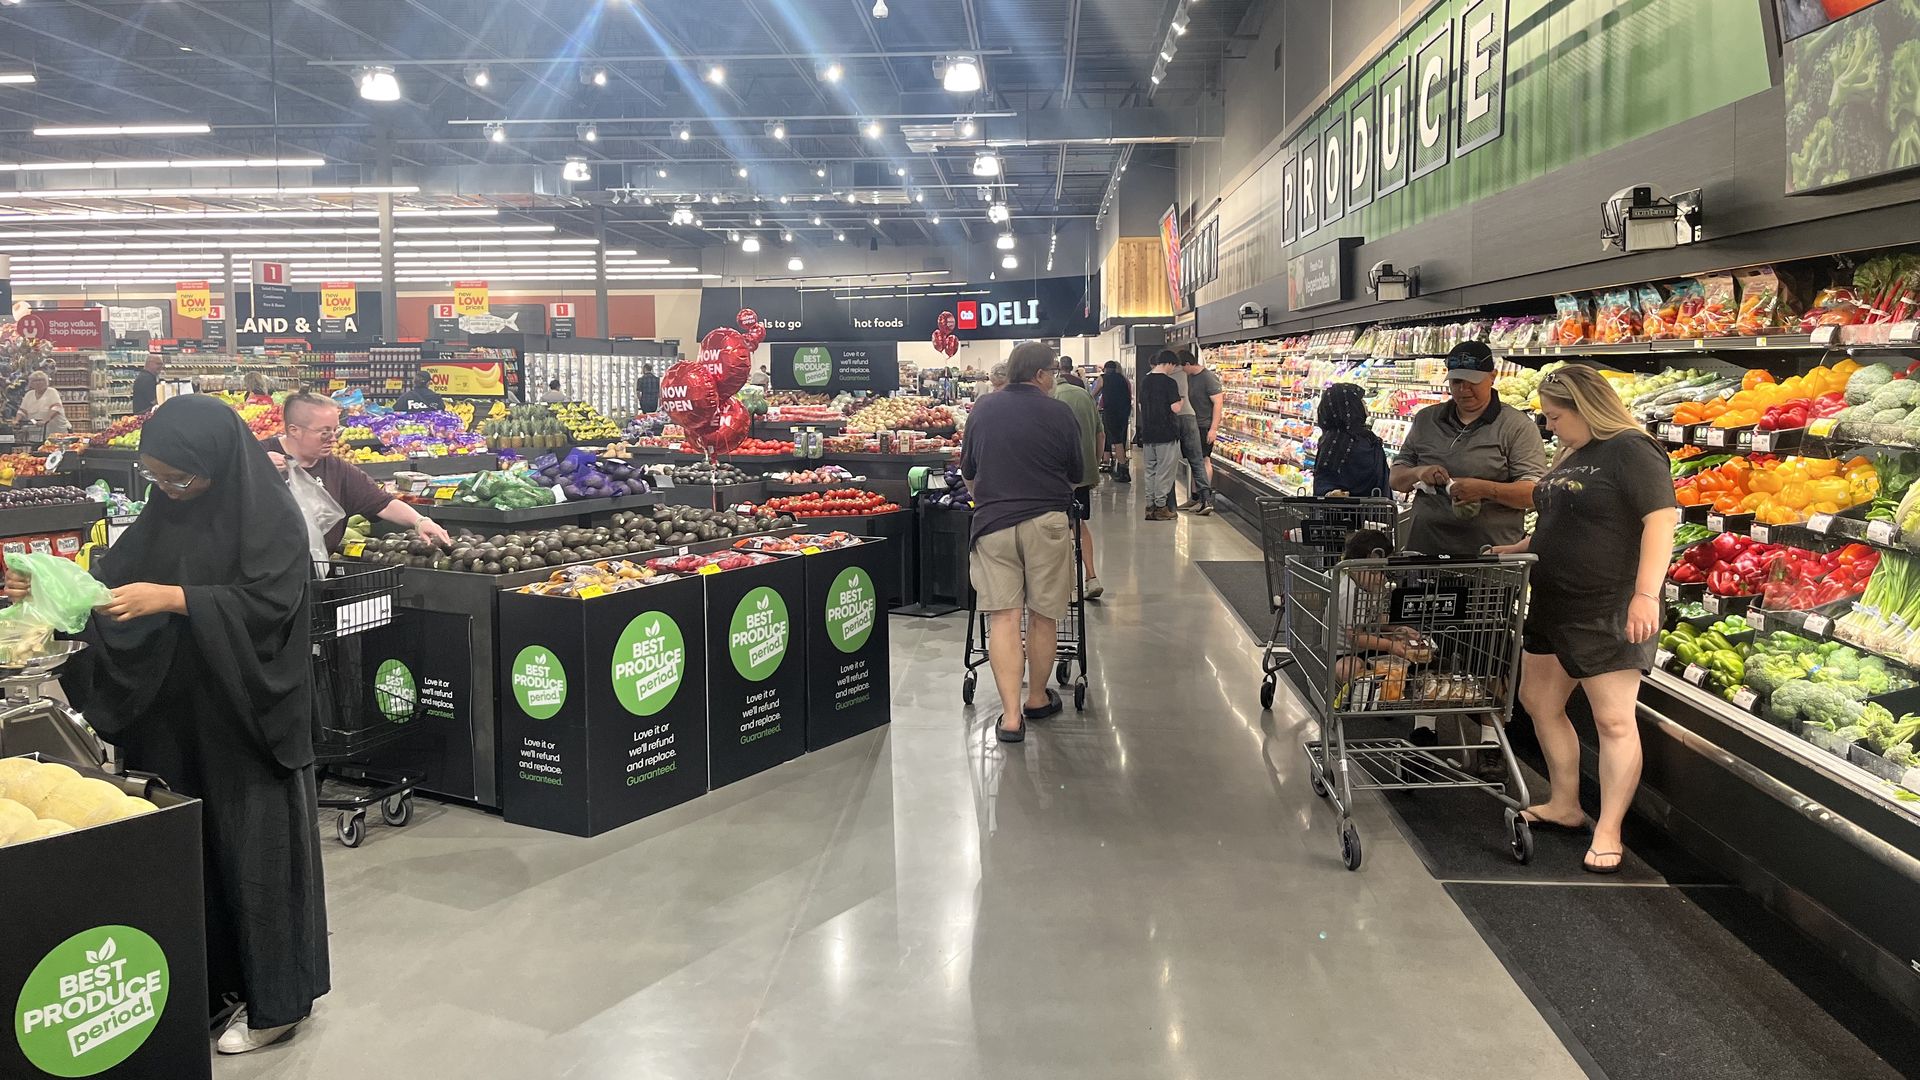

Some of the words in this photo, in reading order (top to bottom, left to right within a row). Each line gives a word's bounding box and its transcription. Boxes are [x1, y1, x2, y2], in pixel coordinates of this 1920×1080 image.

[1284, 12, 1494, 230] PRODUCE
[270, 266, 276, 280] 1
[181, 299, 206, 308] LOW
[326, 298, 351, 306] LOW
[459, 297, 484, 306] LOW
[443, 306, 449, 316] 2
[980, 300, 1040, 326] DELI
[49, 320, 70, 329] Shop
[295, 318, 312, 333] &
[775, 320, 786, 328] to
[786, 321, 802, 331] go
[854, 318, 872, 328] hot
[874, 318, 904, 328] foods
[49, 328, 70, 336] Shop
[804, 354, 821, 363] BEST
[794, 362, 830, 371] PRODUCE
[430, 374, 450, 386] OW
[662, 386, 688, 398] NOW
[663, 400, 694, 412] OPEN
[840, 588, 862, 605] BEST
[828, 598, 874, 622] PRODUCE
[746, 610, 774, 629] BEST
[844, 614, 870, 638] period.
[732, 620, 786, 648] PRODUCE
[632, 636, 665, 659] BEST
[752, 635, 782, 664] period.
[526, 664, 550, 678] BEST
[616, 648, 682, 680] PRODUCE
[840, 664, 854, 674] Love
[854, 660, 859, 669] it
[859, 660, 865, 668] or
[386, 675, 404, 685] BEST
[424, 677, 437, 685] Love
[514, 674, 564, 691] PRODUCE
[639, 665, 676, 698] period.
[837, 674, 850, 687] we'll
[850, 669, 869, 682] refund
[376, 684, 414, 700] PRODUCE
[434, 690, 453, 698] refund
[530, 692, 559, 704] period.
[746, 693, 762, 704] Love
[763, 689, 768, 699] it
[768, 688, 776, 697] or
[836, 688, 848, 699] and
[848, 682, 870, 696] replace.
[421, 697, 432, 705] and
[742, 705, 758, 718] we'll
[758, 698, 780, 714] refund
[740, 719, 754, 732] and
[755, 712, 781, 728] replace.
[634, 729, 653, 742] Love
[654, 724, 660, 735] it
[661, 723, 670, 732] or
[740, 724, 781, 745] Guaranteed.
[524, 737, 540, 746] Love
[541, 740, 547, 748] it
[548, 742, 555, 750] or
[628, 742, 647, 758] we'll
[648, 734, 674, 752] refund
[521, 748, 536, 758] we'll
[536, 752, 560, 762] refund
[626, 758, 643, 772] and
[644, 749, 676, 766] replace.
[519, 760, 532, 770] and
[534, 762, 562, 774] replace.
[626, 761, 677, 786] Guaranteed.
[519, 771, 563, 786] Guaranteed.
[59, 958, 127, 999] BEST
[24, 970, 162, 1034] PRODUCE
[72, 996, 152, 1052] period.
